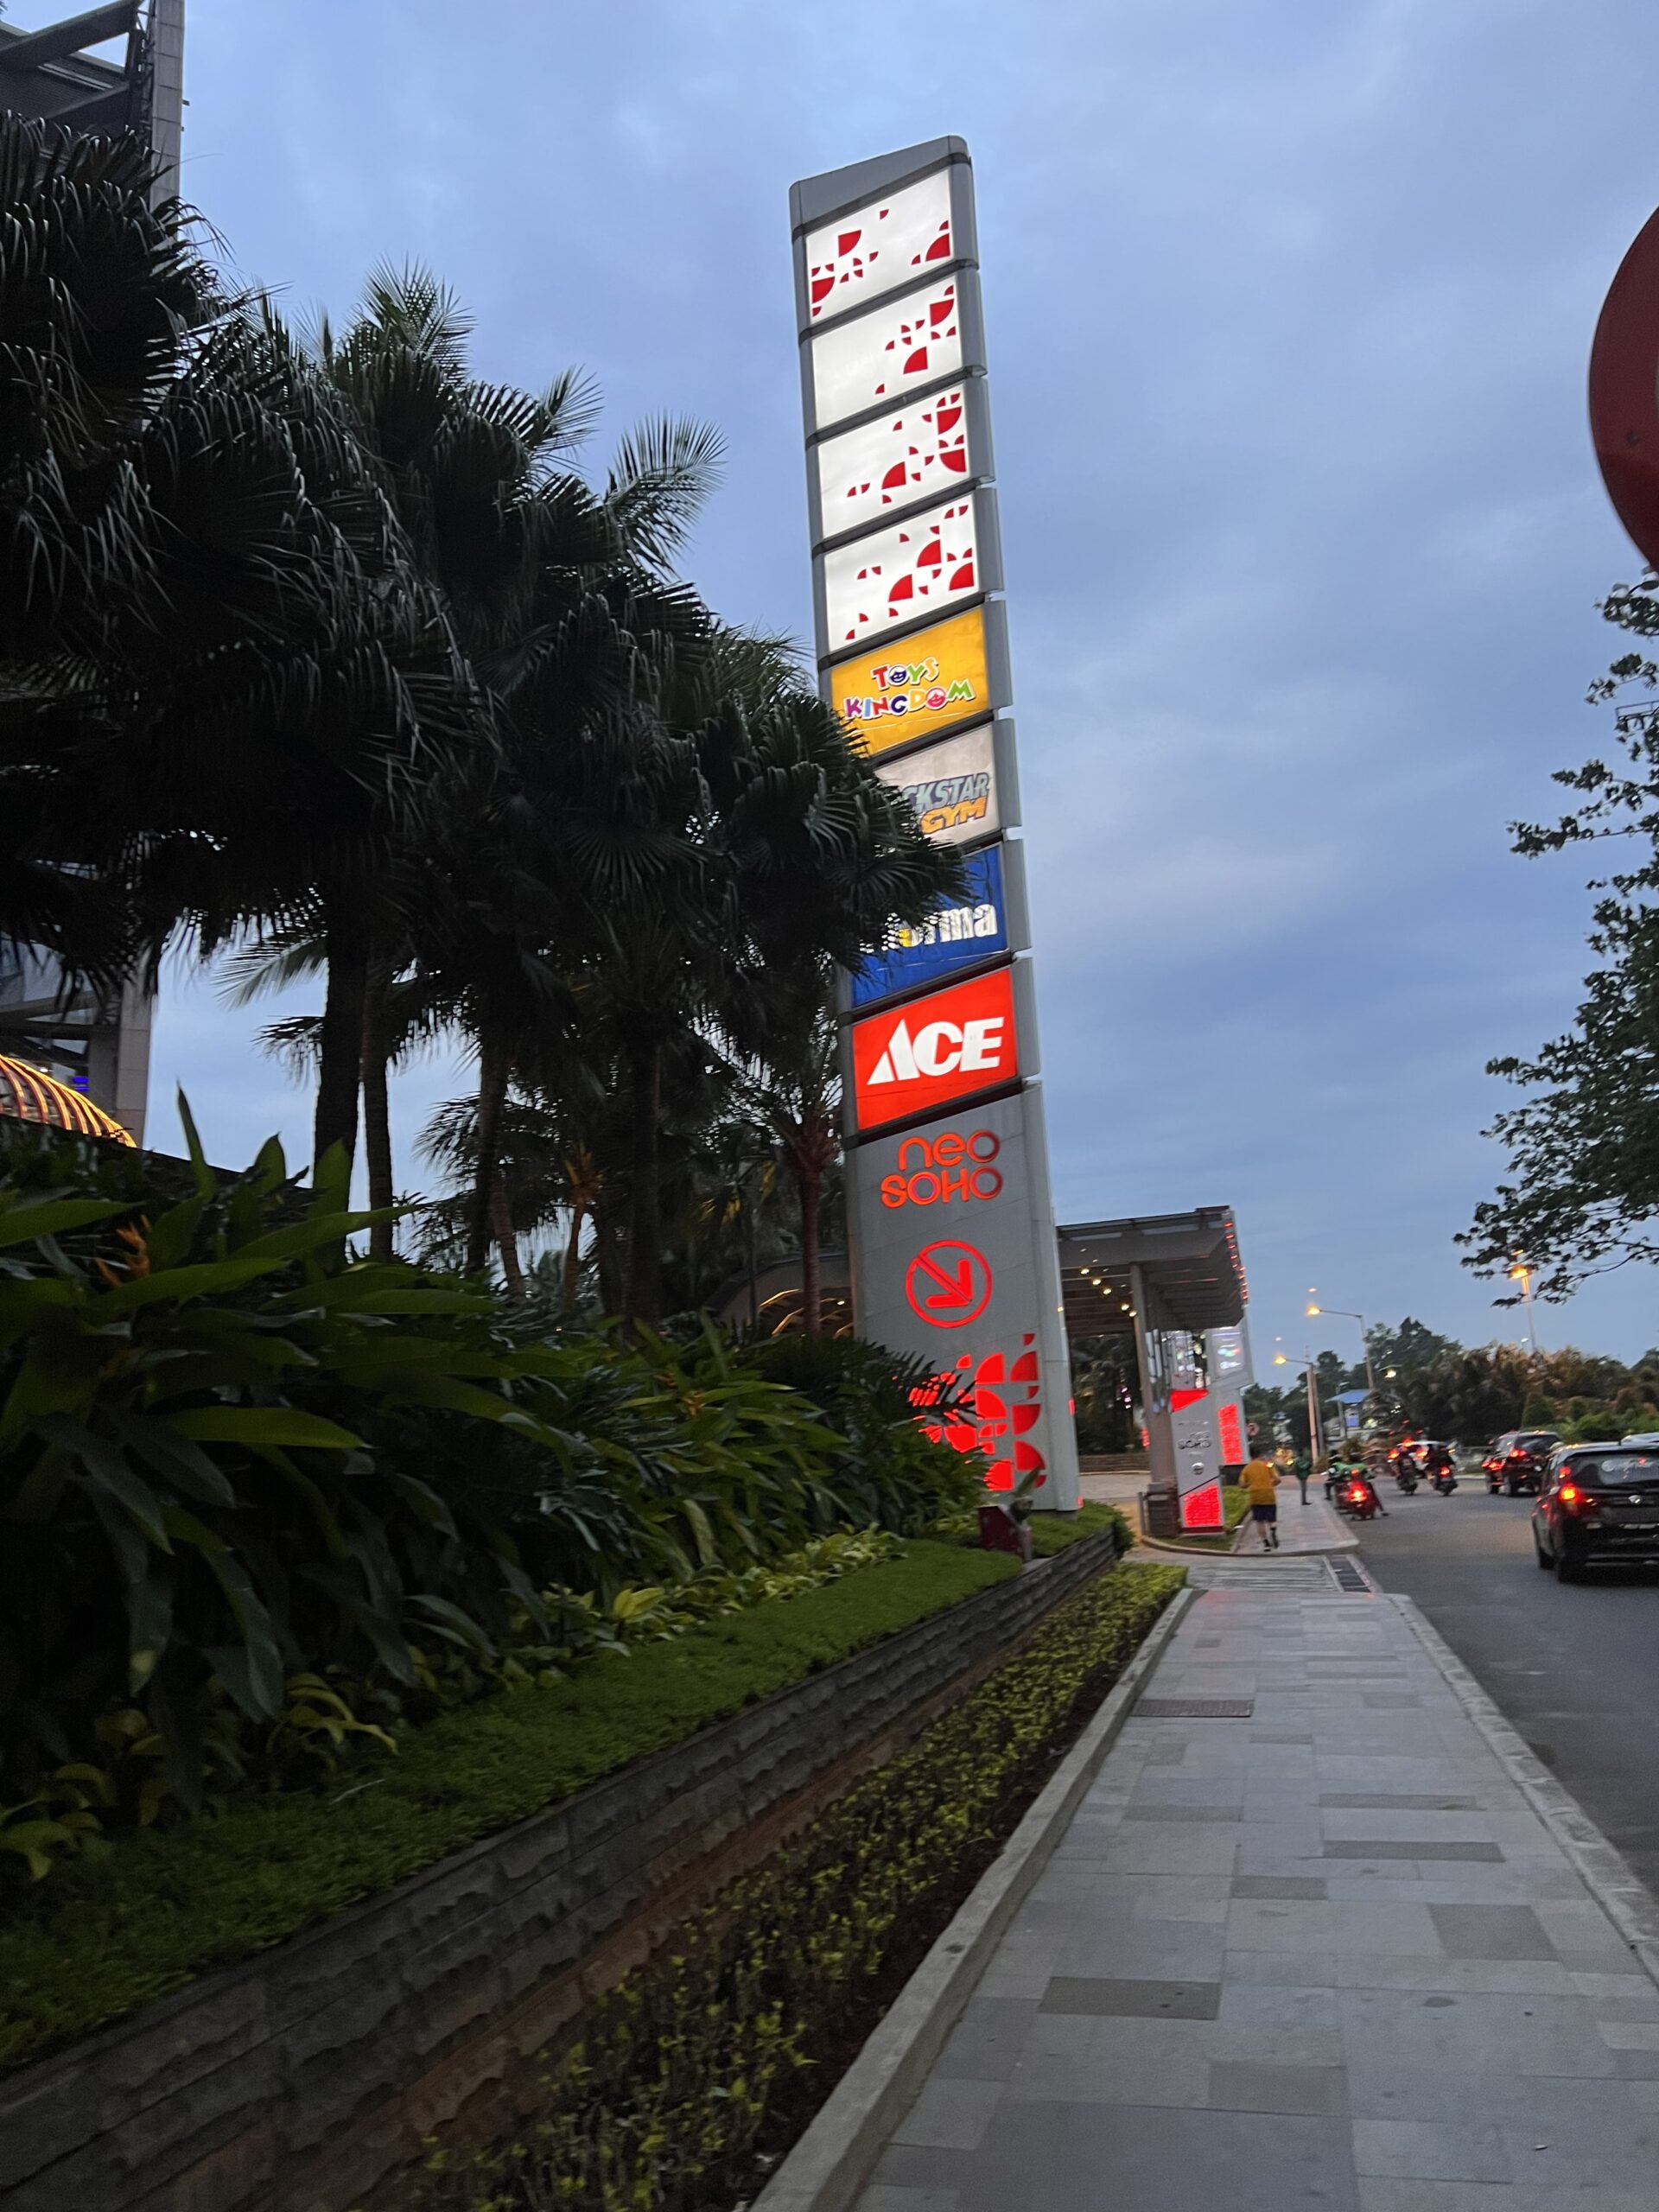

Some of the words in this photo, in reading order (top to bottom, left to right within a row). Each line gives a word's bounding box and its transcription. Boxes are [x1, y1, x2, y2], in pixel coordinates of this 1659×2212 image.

[871, 657, 939, 690] TOYS
[843, 678, 976, 720] KINGDOM
[900, 772, 989, 814] CKSTAR
[920, 796, 988, 835] GYM
[867, 1016, 1004, 1085] ACE
